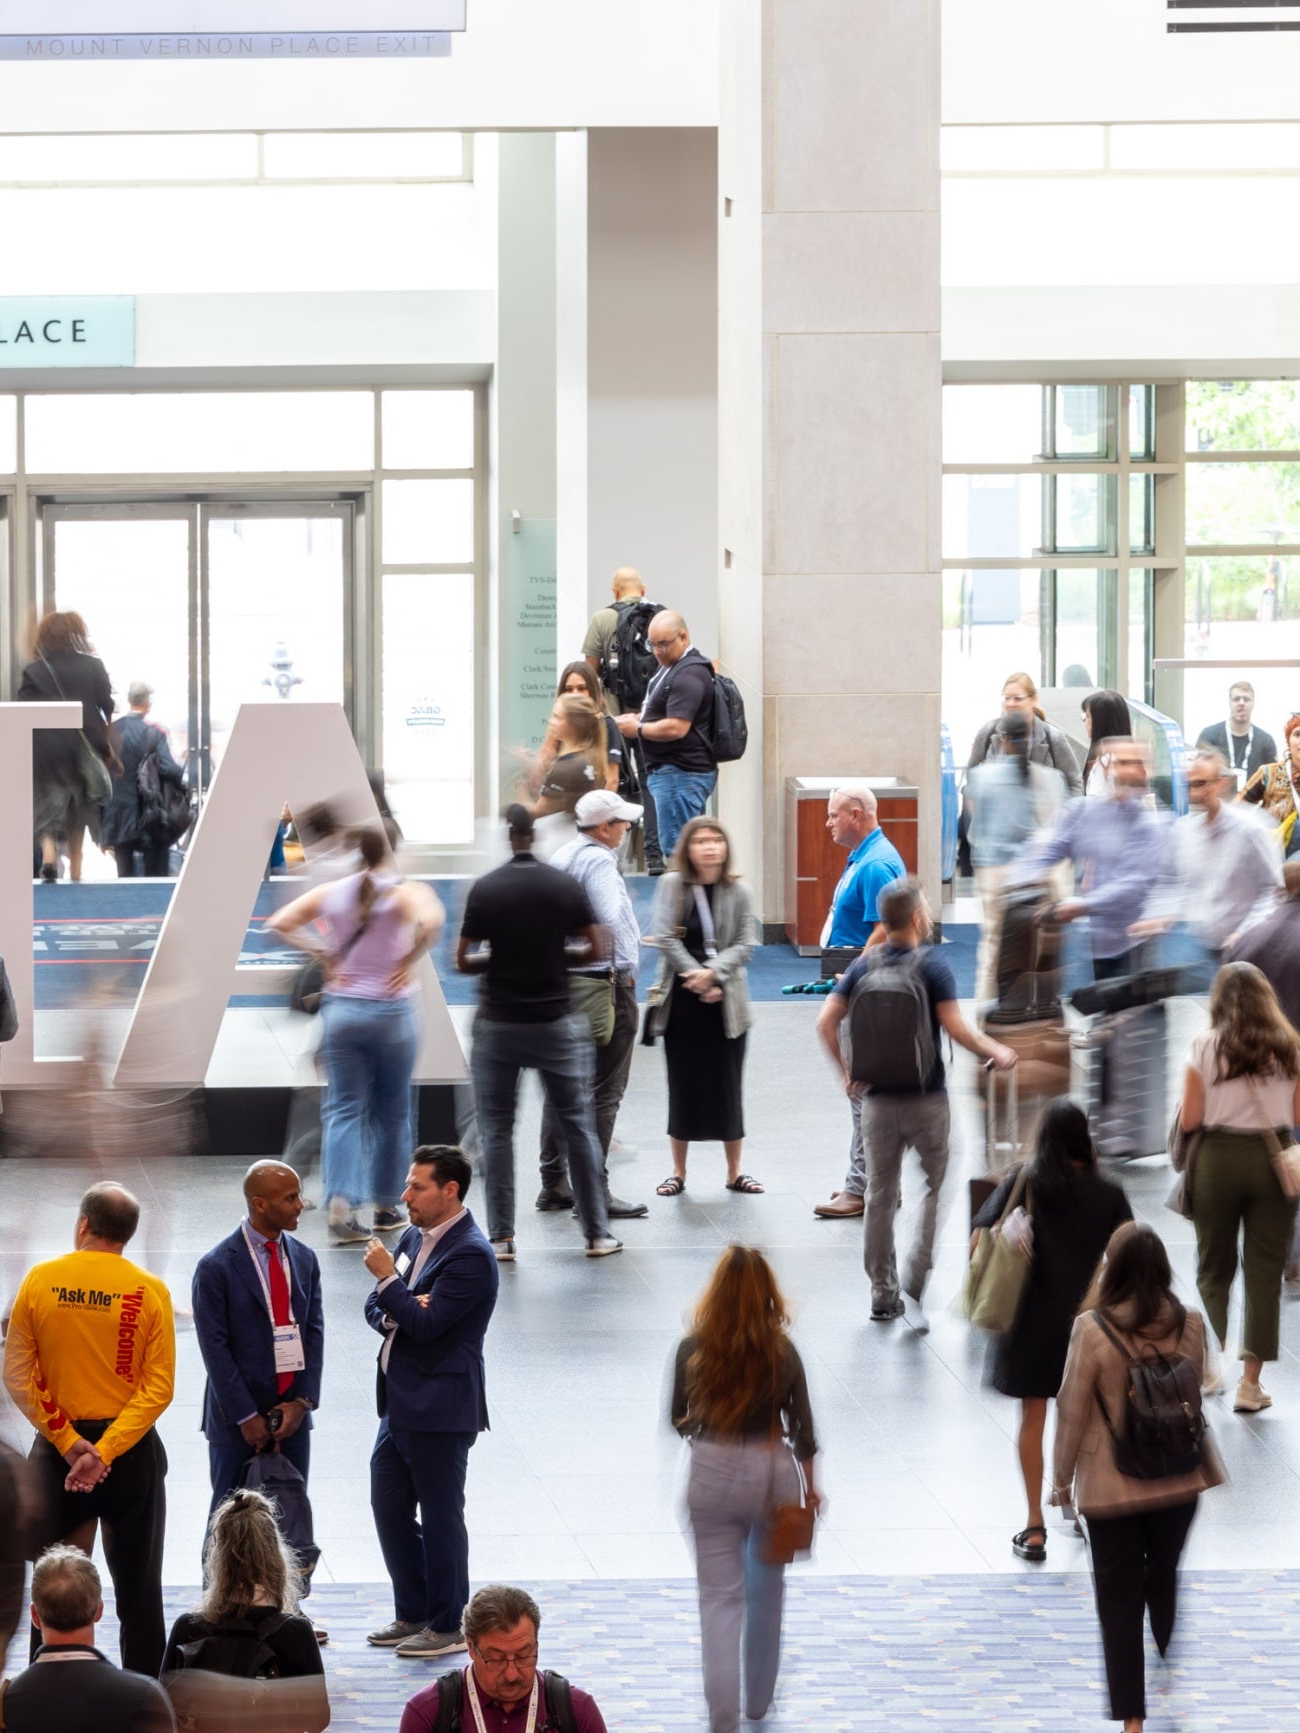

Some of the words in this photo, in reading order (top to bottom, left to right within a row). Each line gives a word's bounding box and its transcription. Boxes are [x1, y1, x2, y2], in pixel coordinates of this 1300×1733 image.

[26, 38, 124, 56] MOUNT
[140, 37, 253, 55] VERNON
[271, 36, 359, 53] PLACE
[376, 35, 436, 53] EXIT
[52, 1287, 86, 1303] "Ask
[88, 1290, 122, 1306] Me"
[115, 1286, 145, 1384] "Welcome"
